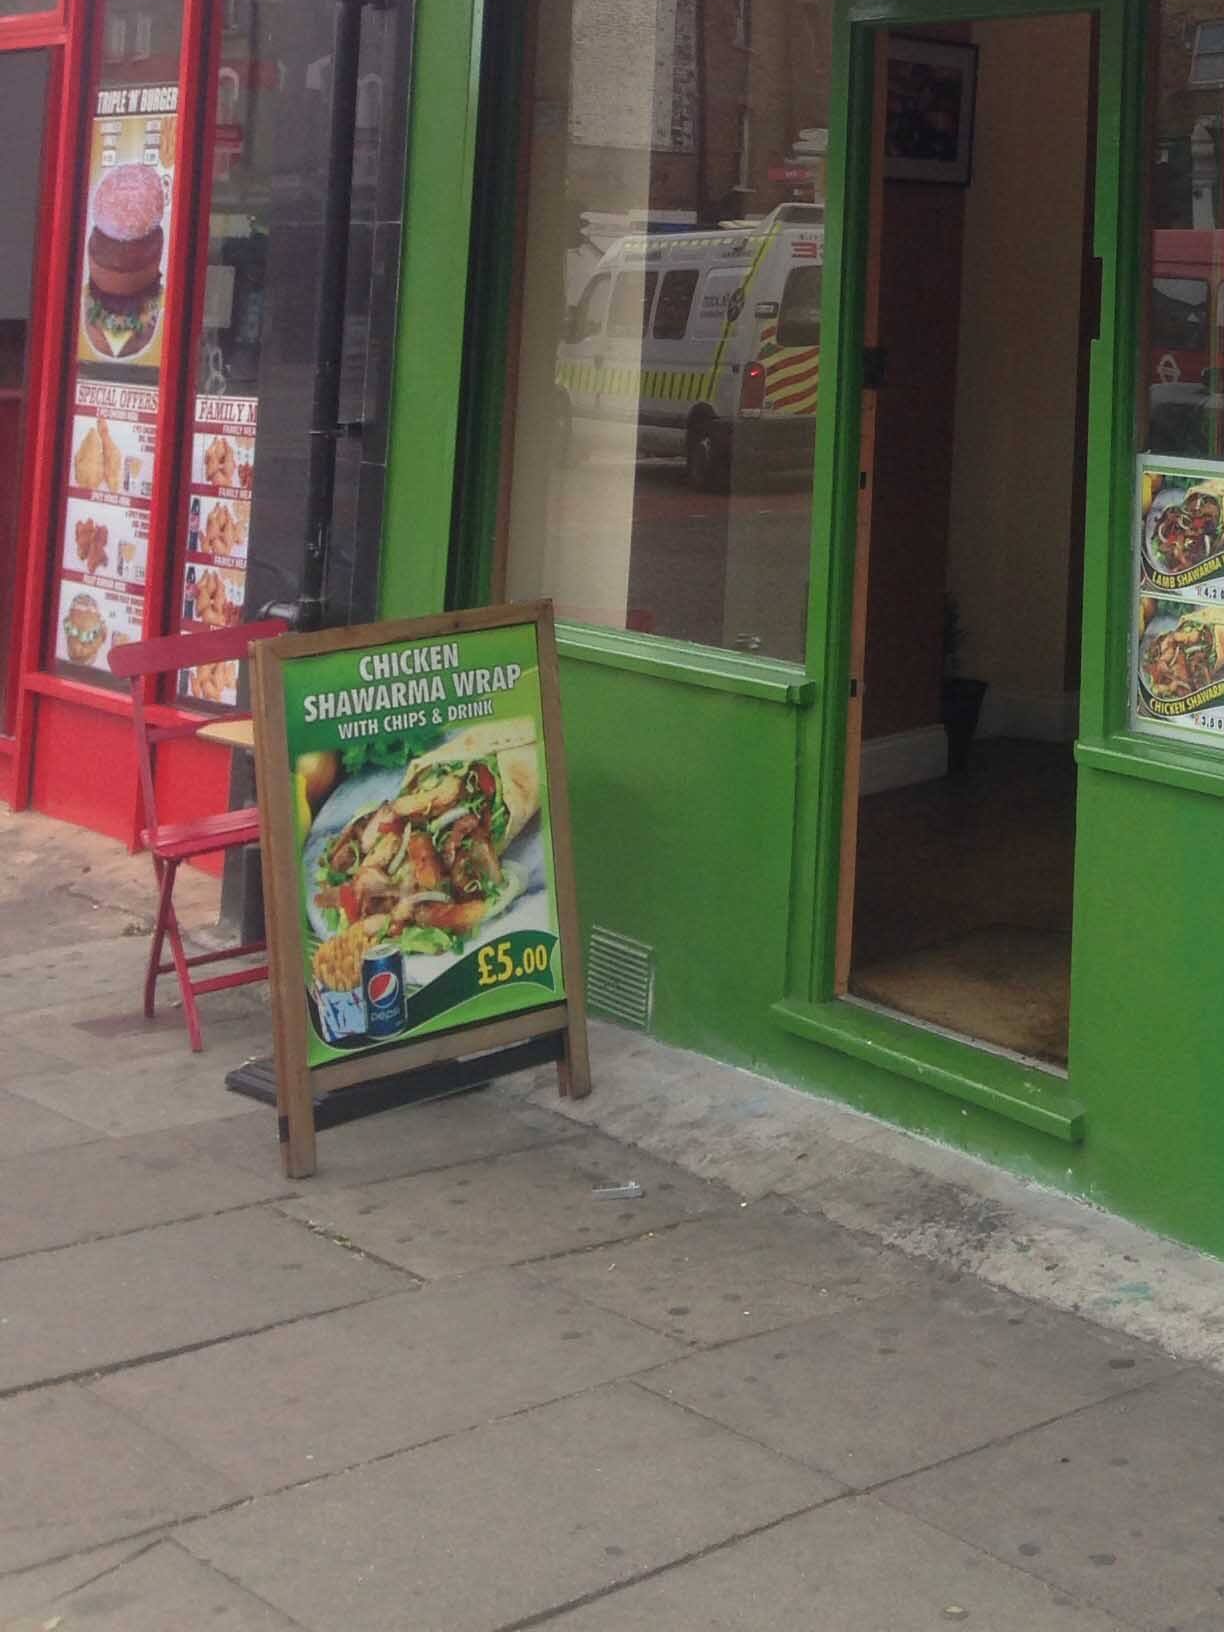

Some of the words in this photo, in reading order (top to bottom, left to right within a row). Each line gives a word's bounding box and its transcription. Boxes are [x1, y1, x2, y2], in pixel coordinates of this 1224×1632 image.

[78, 386, 118, 408] SPECIAL
[119, 389, 158, 411] OFFERS
[199, 401, 245, 422] FAMILY
[1151, 570, 1176, 588] LAMB
[1176, 556, 1222, 587] SHAWARMA
[358, 643, 460, 682] CHICKEN
[302, 675, 446, 723] SHAWARMA
[452, 664, 522, 698] WRAP
[1150, 699, 1186, 715] CHICKEN
[337, 718, 379, 740] WITH
[383, 709, 427, 733] CHIPS
[431, 707, 443, 725] &
[447, 699, 494, 721] DRINK
[477, 941, 548, 985] £5.00
